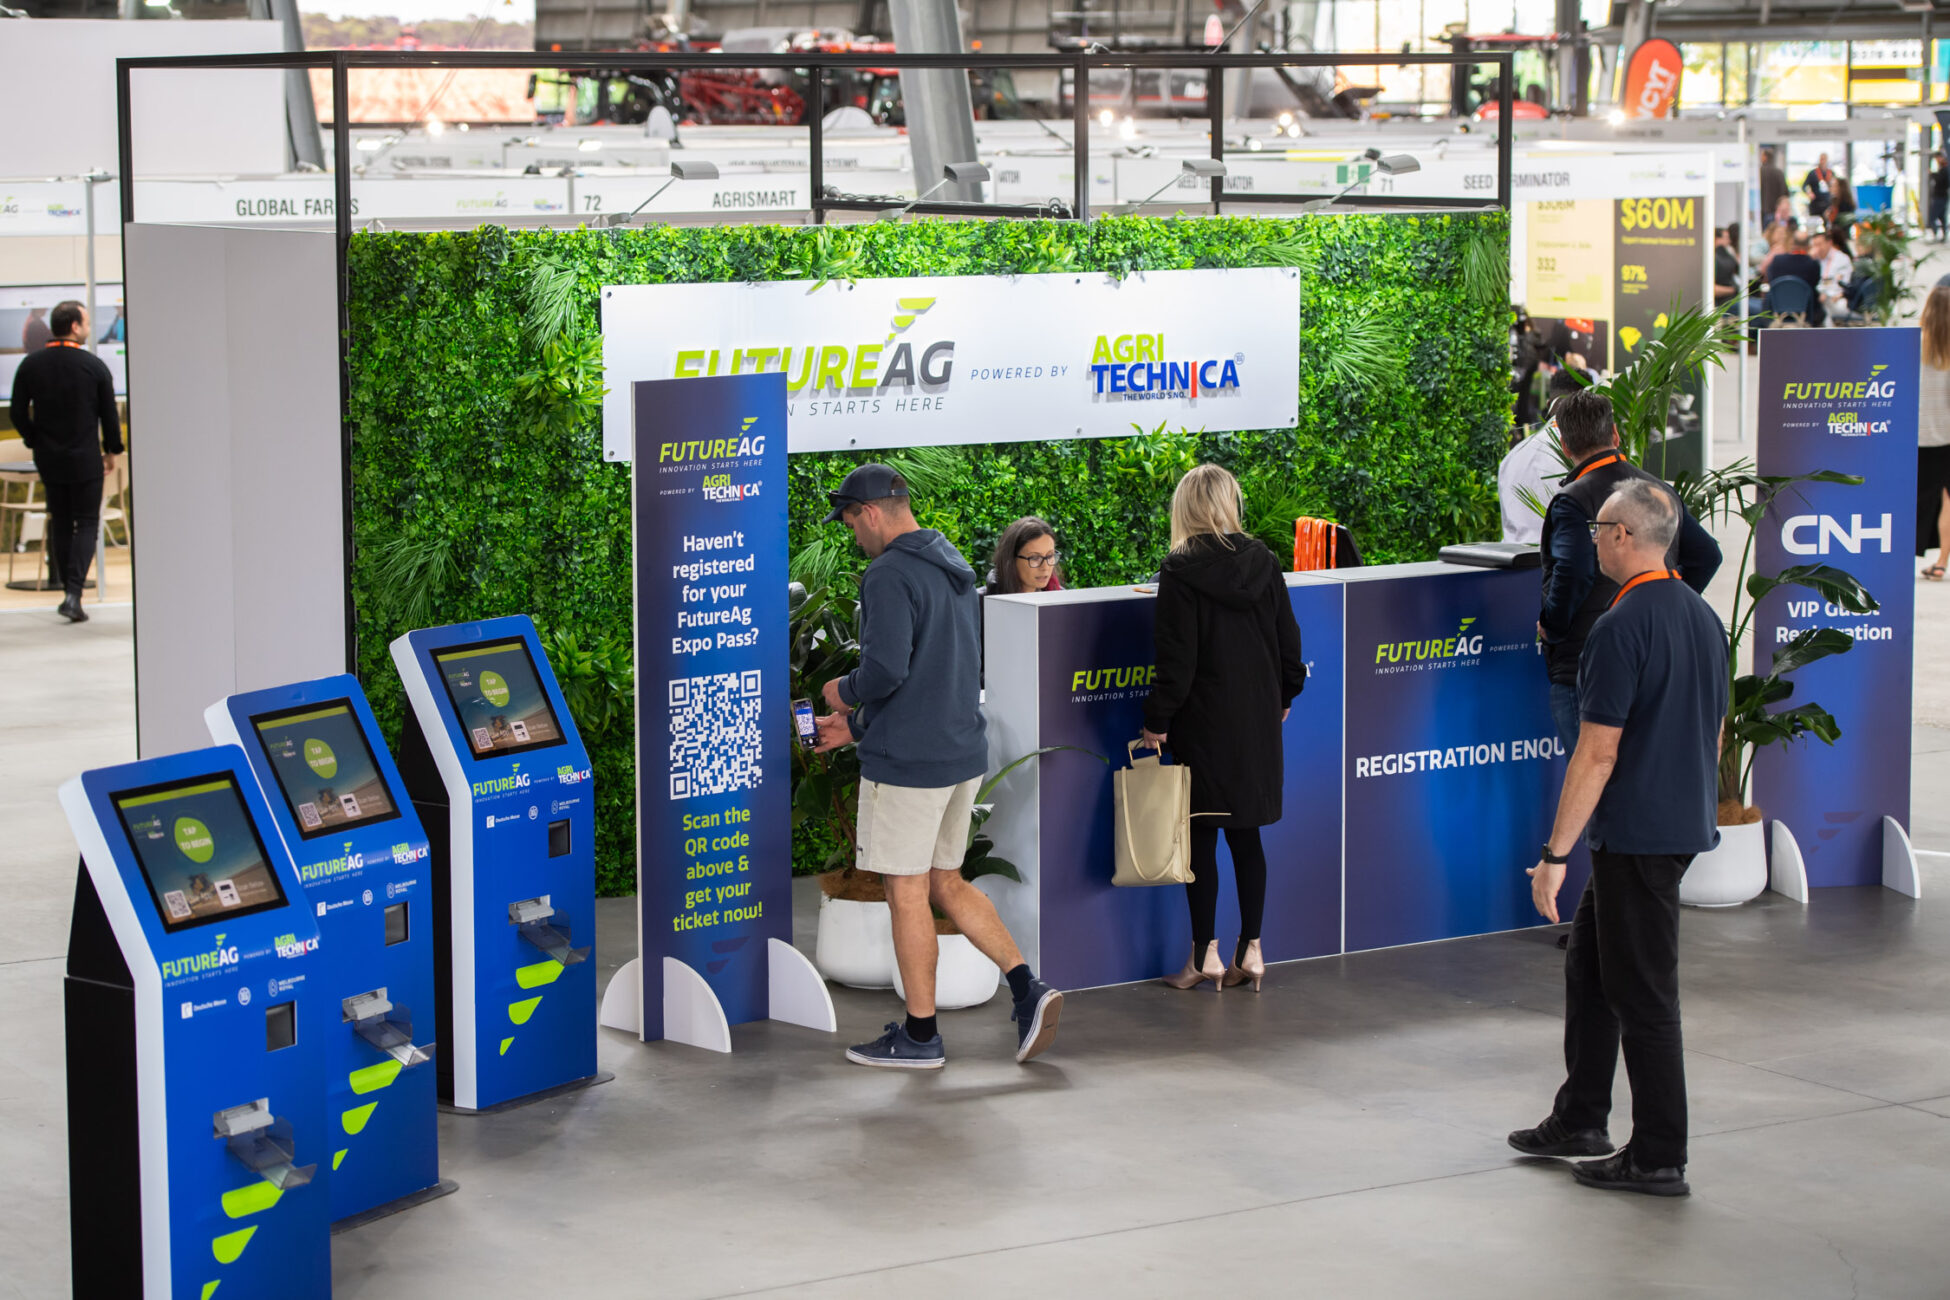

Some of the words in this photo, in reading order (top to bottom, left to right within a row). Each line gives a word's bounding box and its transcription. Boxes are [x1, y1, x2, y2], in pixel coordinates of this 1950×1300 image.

[1380, 178, 1394, 192] 71
[1463, 174, 1493, 190] SEED
[236, 198, 299, 216] GLOBAL
[304, 198, 360, 216] FARS
[583, 195, 602, 211] 72
[712, 190, 797, 209] AGRISMART
[1620, 197, 1695, 231] $60M
[1091, 332, 1165, 364] AGRI
[970, 366, 1043, 381] POWERED
[1050, 365, 1069, 377] BY
[1783, 380, 1896, 400] FUTUREAG
[809, 399, 881, 416] STARTS
[895, 396, 945, 412] HERE
[1782, 401, 1833, 409] INNOVATION
[1871, 400, 1893, 408] HERE
[1827, 411, 1859, 424] AGRI
[659, 435, 766, 463] FUTUREAG
[658, 463, 707, 474] INNOVATION
[711, 460, 740, 470] STARTS
[743, 458, 764, 467] HERE
[702, 473, 732, 489] AGRI
[683, 530, 745, 552] Haven't
[1781, 513, 1892, 555] CNH
[672, 554, 755, 582] registered
[682, 585, 707, 603] for
[710, 582, 747, 605] your
[677, 606, 752, 628] FutureAg
[1787, 601, 1820, 618] VIP
[672, 637, 713, 657] Expo
[716, 627, 760, 649] Pass?
[1374, 634, 1484, 664] FUTUREAG
[1489, 643, 1519, 653] POWERED
[1375, 664, 1424, 675] INNOVATION
[1427, 660, 1457, 671] STARTS
[1460, 658, 1481, 667] HERE
[1071, 691, 1125, 704] INNOVATION
[1129, 689, 1153, 699] STAR
[557, 764, 574, 775] AGRI
[1355, 742, 1505, 779] REGISTRATION
[472, 773, 531, 797] FUTUREAG
[682, 812, 721, 831] Scan
[724, 806, 751, 825] the
[182, 826, 197, 836] TAP
[180, 841, 191, 850] TO
[391, 842, 410, 854] AGRI
[685, 836, 708, 857] QR
[711, 831, 750, 850] code
[301, 852, 364, 881] FUTUREAG
[686, 860, 735, 880] above
[737, 855, 750, 872] &
[685, 887, 713, 910] get
[716, 881, 752, 904] your
[672, 910, 719, 932] ticket
[723, 901, 763, 923] now!
[274, 932, 297, 947] AGRI
[161, 946, 240, 980] FUTUREAG
